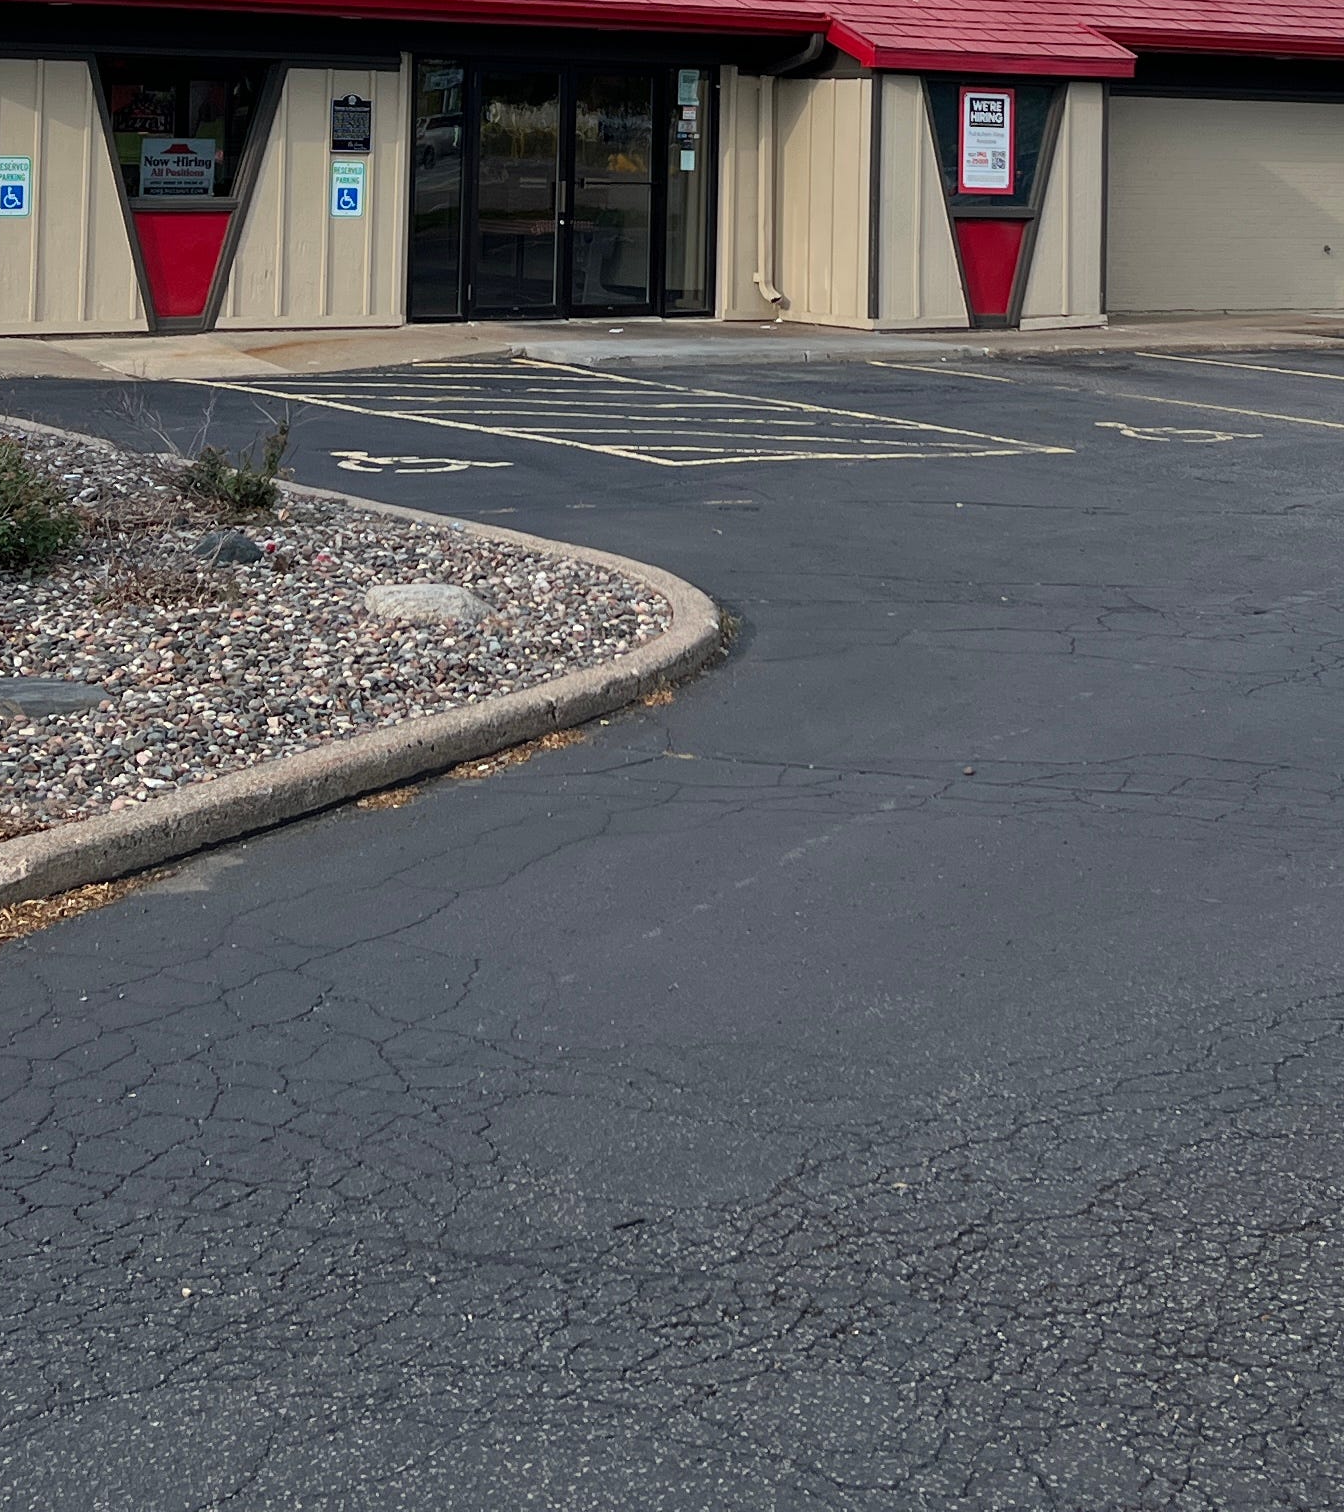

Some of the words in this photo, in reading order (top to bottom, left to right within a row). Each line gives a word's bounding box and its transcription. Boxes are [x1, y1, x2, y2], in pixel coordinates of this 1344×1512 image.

[972, 99, 1003, 112] WE'RE
[970, 111, 1003, 124] HIRING
[144, 155, 170, 167] Now
[151, 167, 164, 176] All
[166, 167, 204, 177] Positions
[333, 166, 363, 175] RESERVED
[335, 176, 360, 185] PARKING
